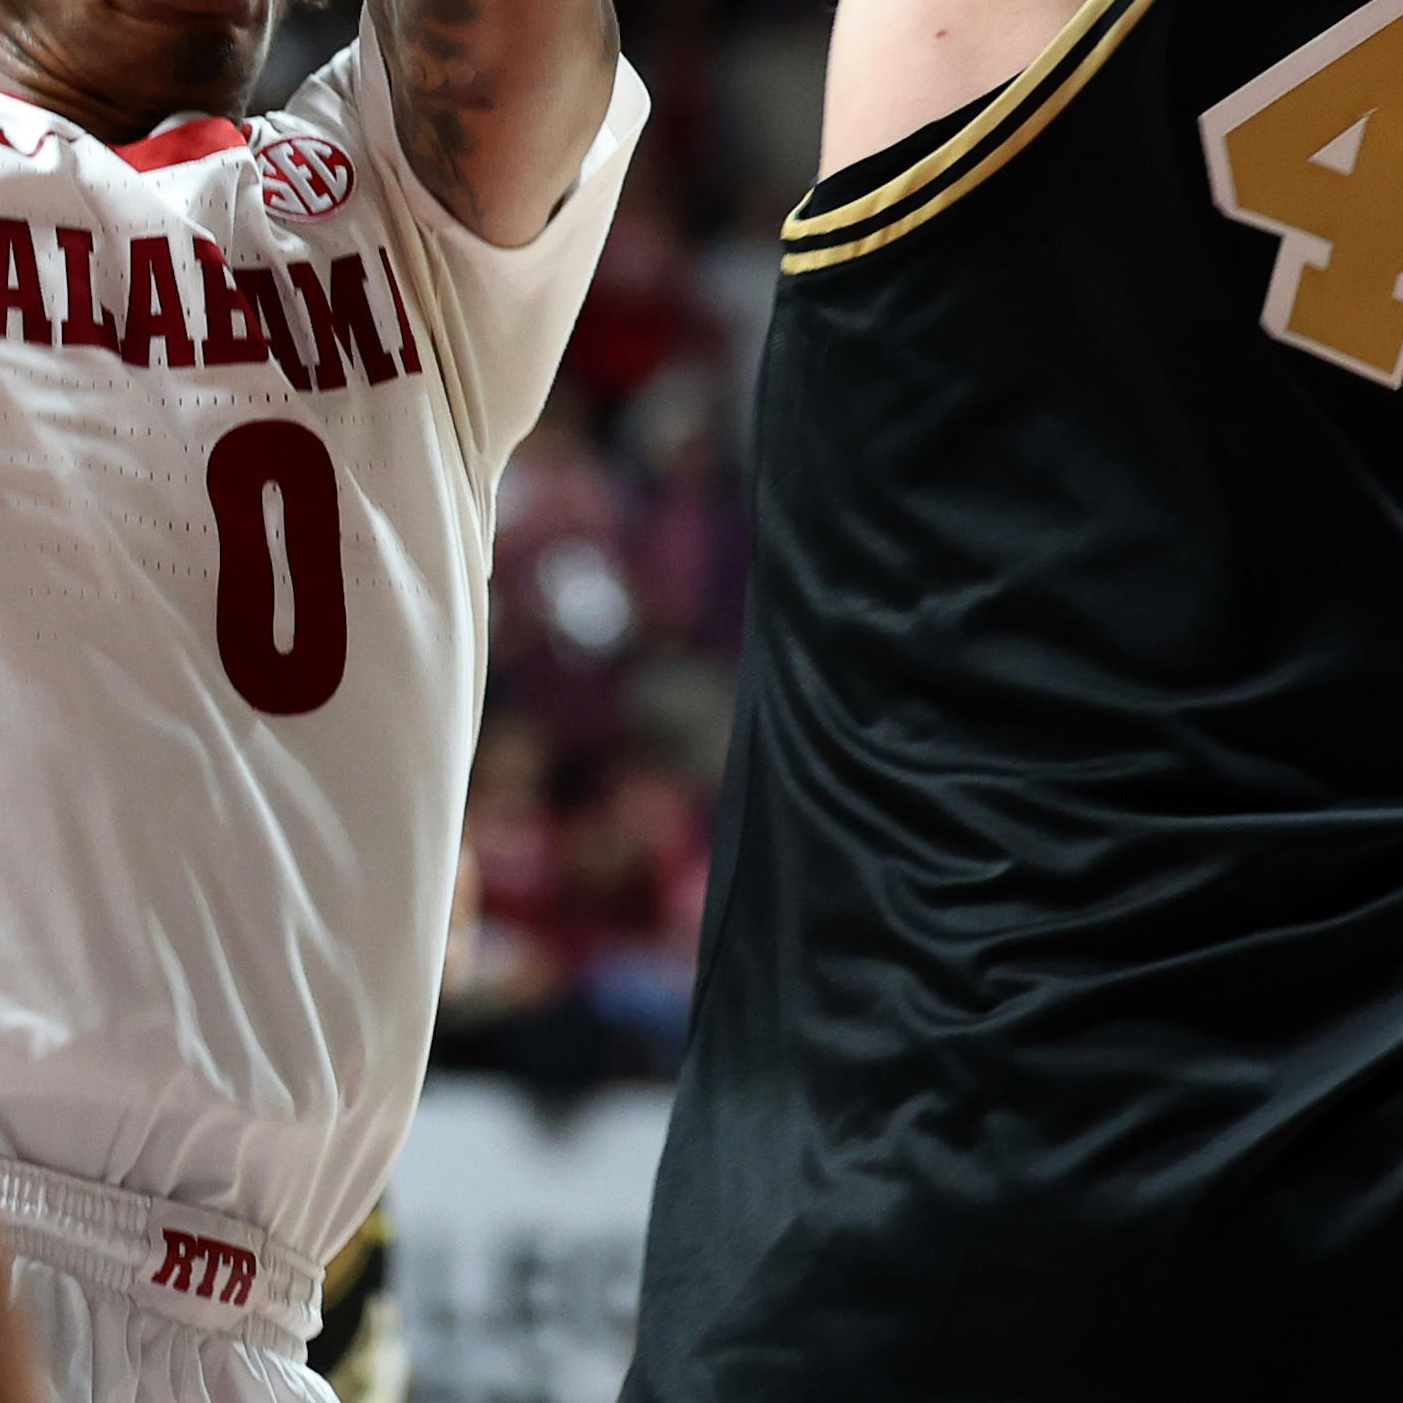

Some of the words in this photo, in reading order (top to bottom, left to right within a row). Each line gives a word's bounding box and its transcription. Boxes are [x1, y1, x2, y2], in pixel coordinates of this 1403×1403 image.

[256, 138, 349, 214] SEC
[206, 418, 348, 716] 0
[151, 1227, 257, 1307] RTR
